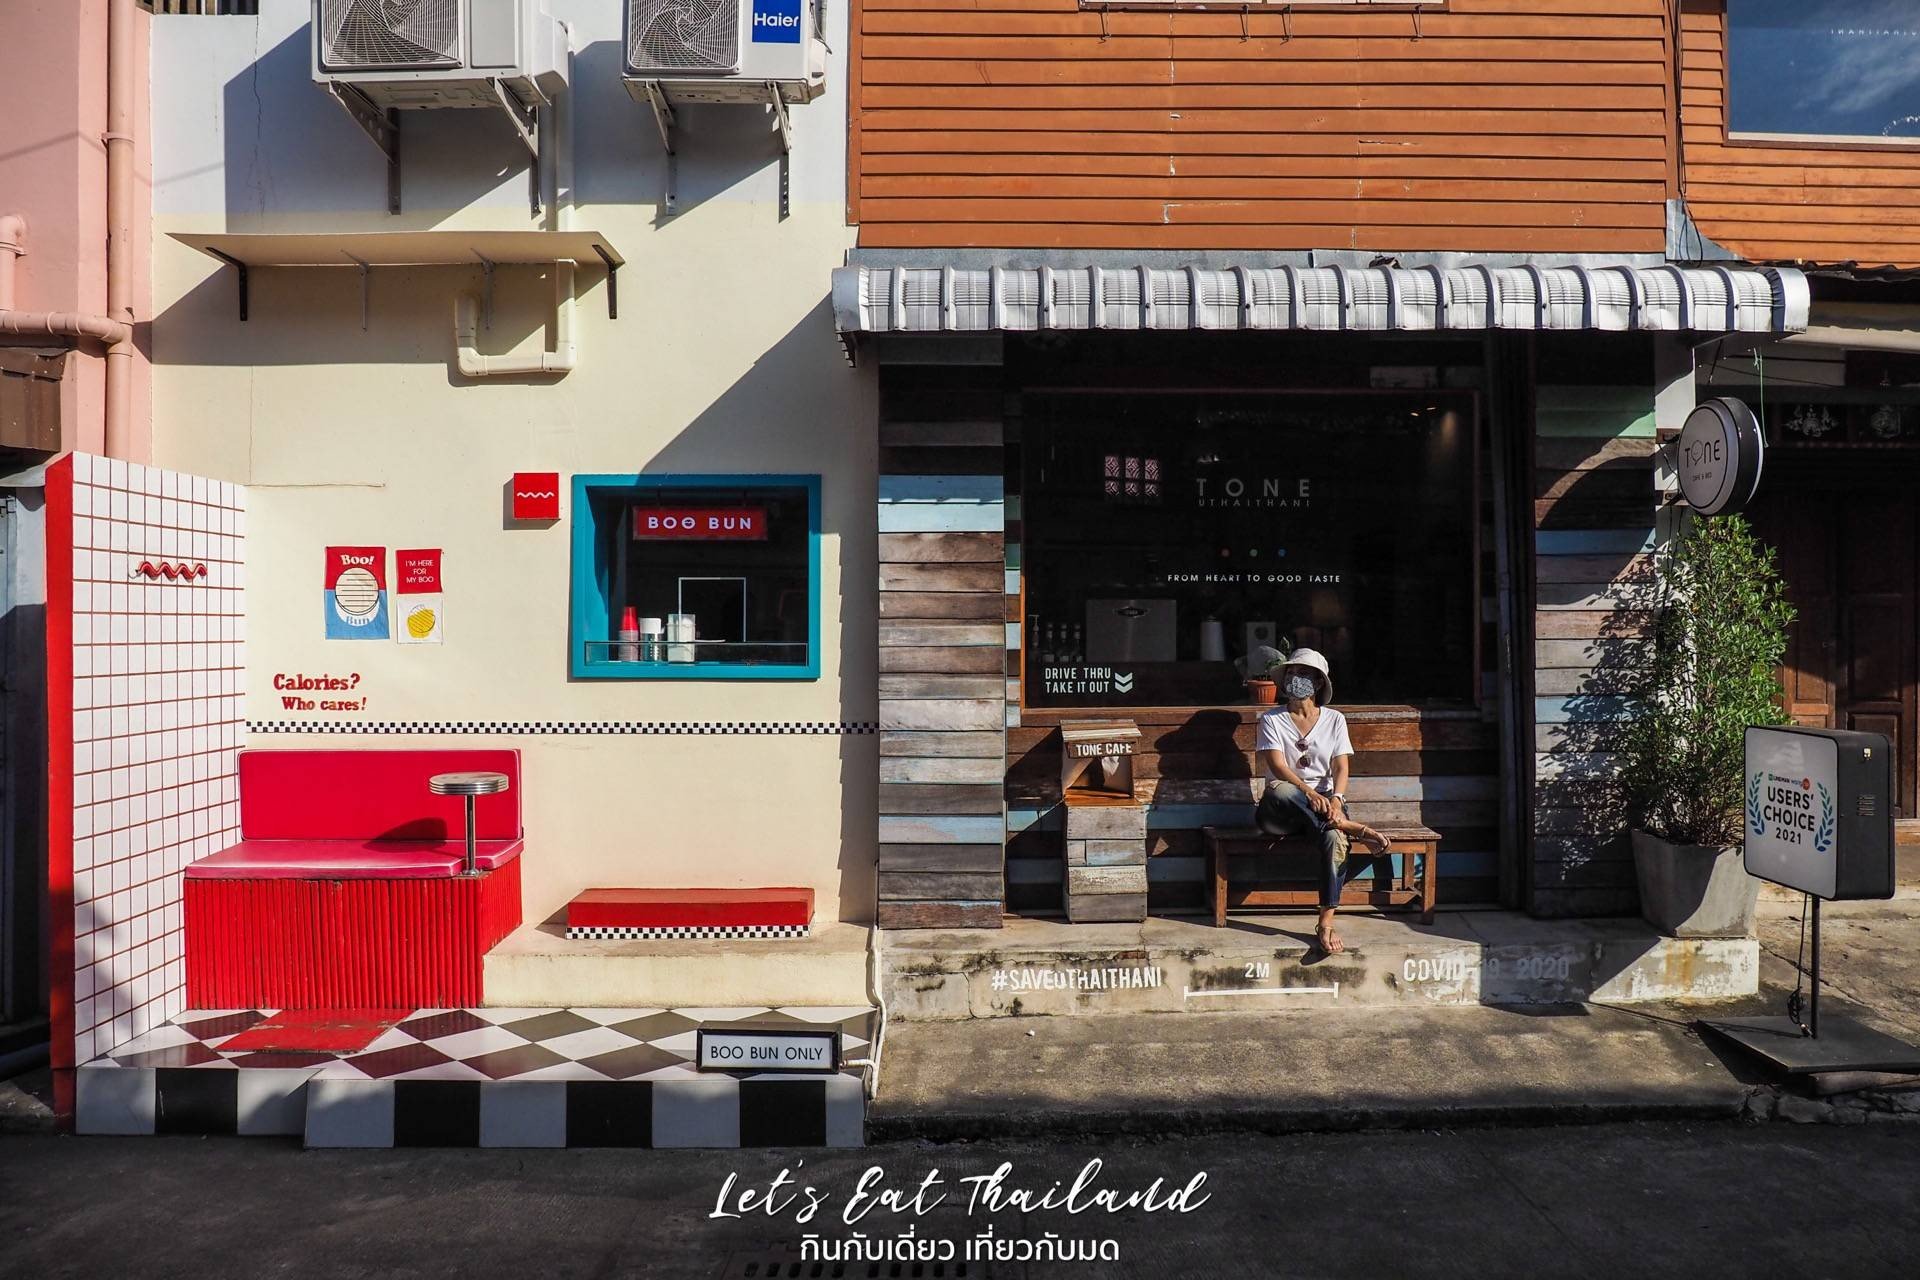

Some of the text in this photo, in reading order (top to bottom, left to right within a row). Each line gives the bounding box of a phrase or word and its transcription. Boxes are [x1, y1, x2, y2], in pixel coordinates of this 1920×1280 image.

[754, 12, 799, 27] Haier
[1684, 439, 1721, 468] TONE
[1196, 478, 1310, 497] TONE
[1198, 499, 1310, 507] UTHAITHANI
[648, 516, 751, 529] BOO BUN
[341, 554, 375, 565] Boo!
[417, 559, 433, 567] HERE
[1167, 574, 1340, 583] FROM HEART TO GOOD TASTE
[1045, 667, 1111, 680] DRIVE THRU
[273, 672, 361, 691] Calories?
[1045, 681, 1109, 693] TAKE IT OUT
[281, 696, 367, 711] Who cares!
[1076, 742, 1133, 756] TONE CAFE
[1763, 805, 1815, 832] CHOICE
[1775, 827, 1802, 845] 2021
[1244, 962, 1270, 978] 2M
[1516, 957, 1570, 980] 2020
[711, 1046, 823, 1061] BOO BUN ONLY
